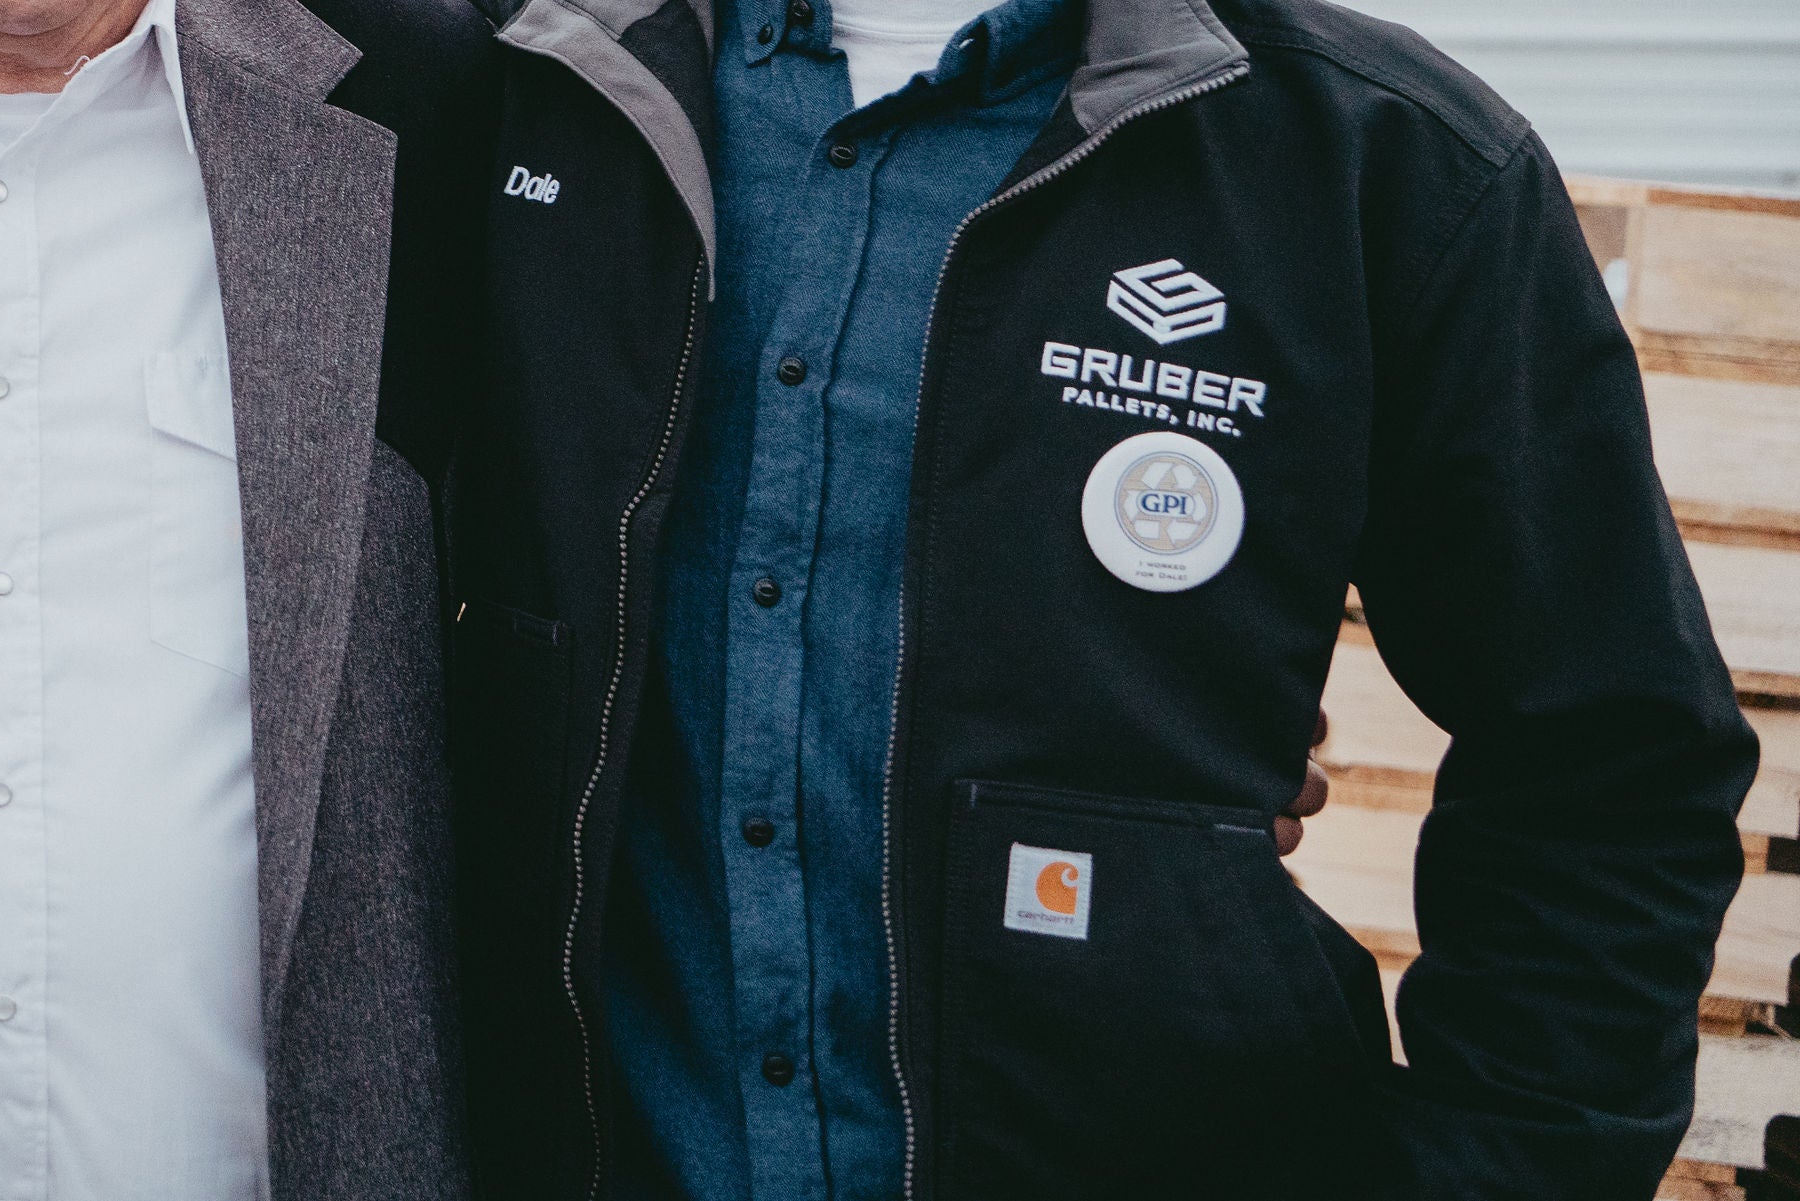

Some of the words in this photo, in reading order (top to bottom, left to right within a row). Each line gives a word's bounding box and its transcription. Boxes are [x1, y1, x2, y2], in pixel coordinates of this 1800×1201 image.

[503, 165, 561, 204] Dale
[1040, 341, 1266, 418] GRUBER
[1062, 386, 1180, 426] PALLETS,
[1187, 409, 1242, 437] INC.
[1140, 493, 1188, 515] GPI
[1017, 910, 1075, 925] carhartt
